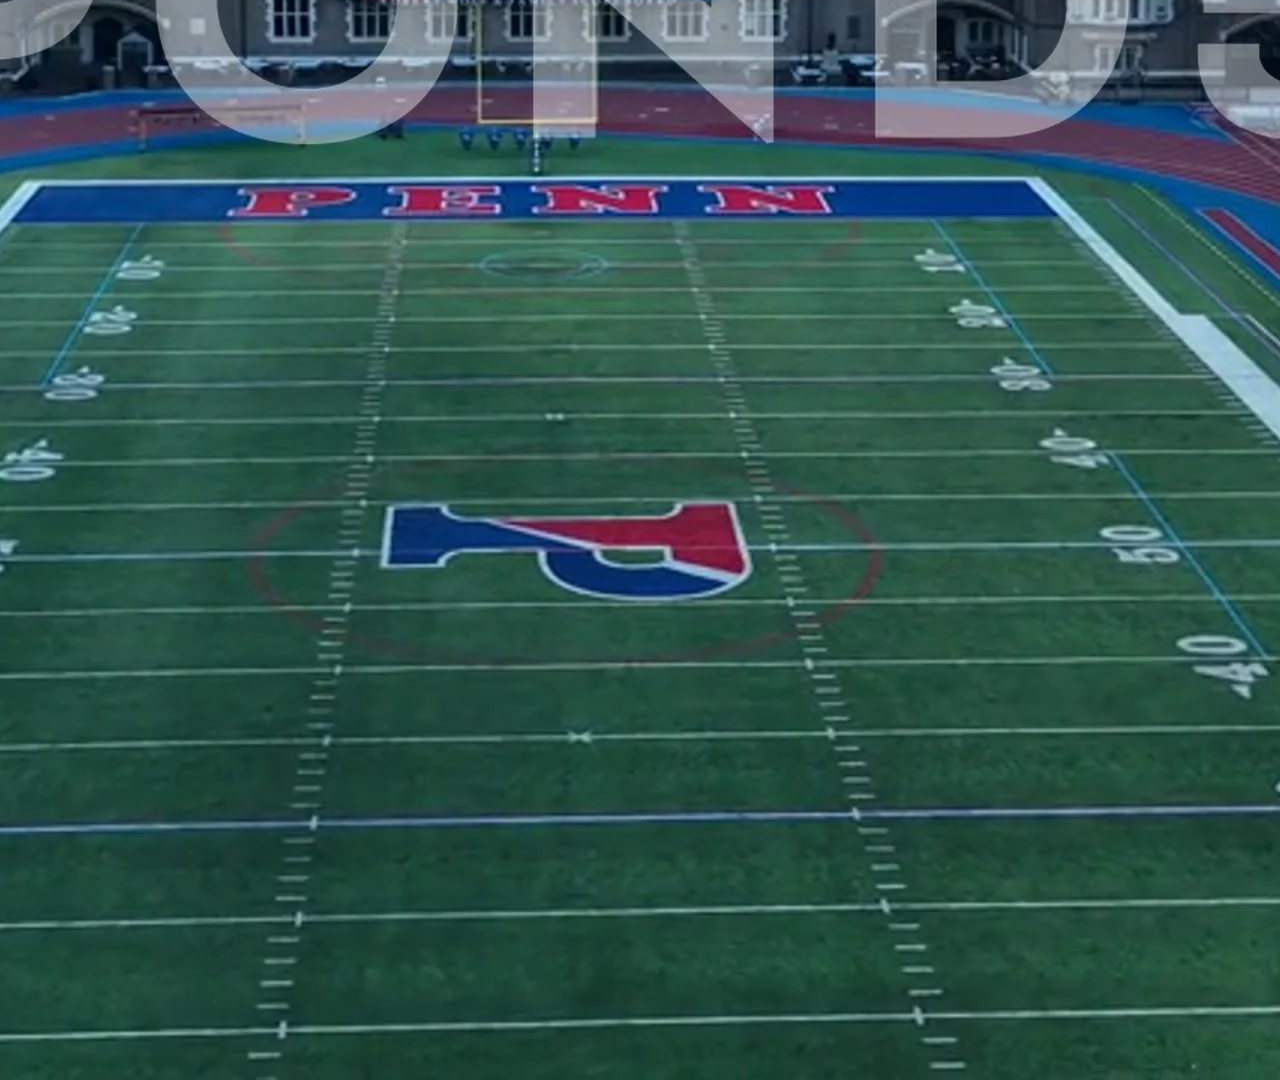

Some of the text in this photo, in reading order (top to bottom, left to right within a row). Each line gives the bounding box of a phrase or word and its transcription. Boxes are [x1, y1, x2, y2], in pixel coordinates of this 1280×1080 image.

[227, 184, 835, 217] PENN
[1099, 525, 1180, 563] 50
[1176, 635, 1269, 682] 40
